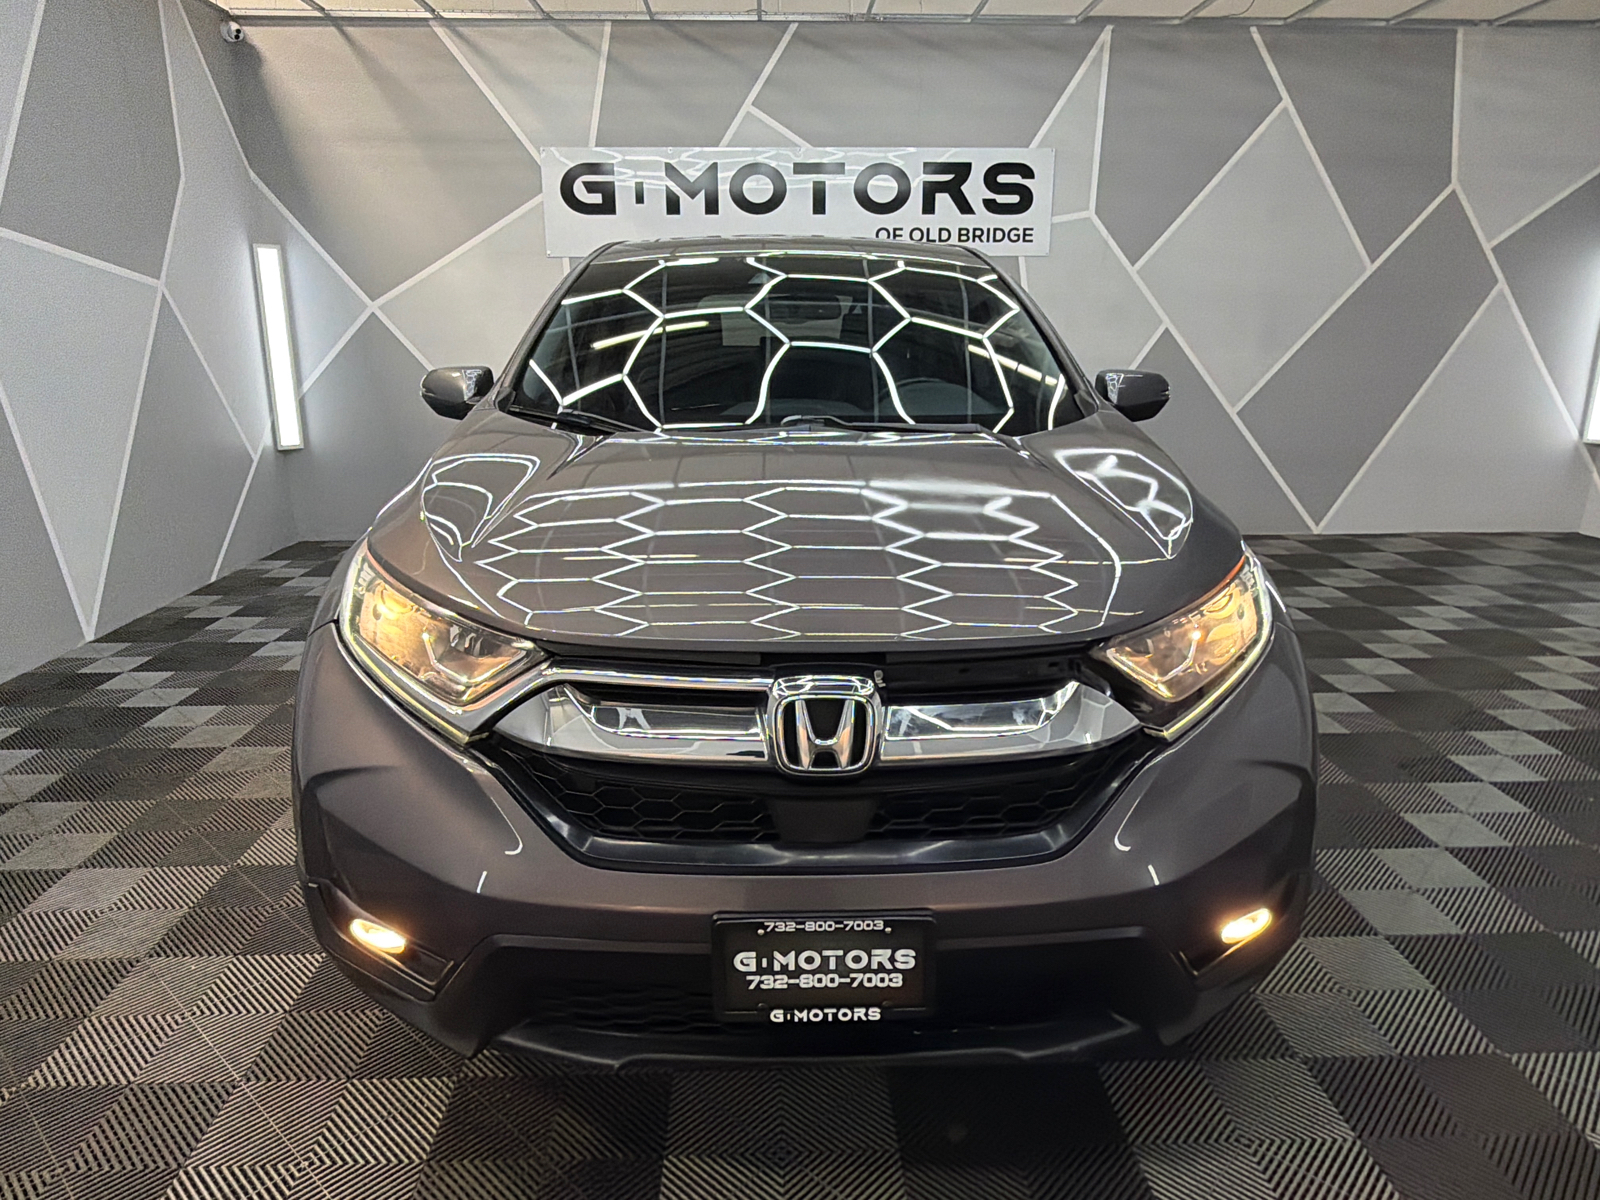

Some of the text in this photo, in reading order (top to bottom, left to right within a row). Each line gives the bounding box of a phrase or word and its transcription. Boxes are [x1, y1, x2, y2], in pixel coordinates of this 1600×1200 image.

[875, 227, 1034, 243] OF OLD BRIDGE
[763, 920, 884, 932] 732-800-7003
[746, 973, 903, 990] 732-800-7003
